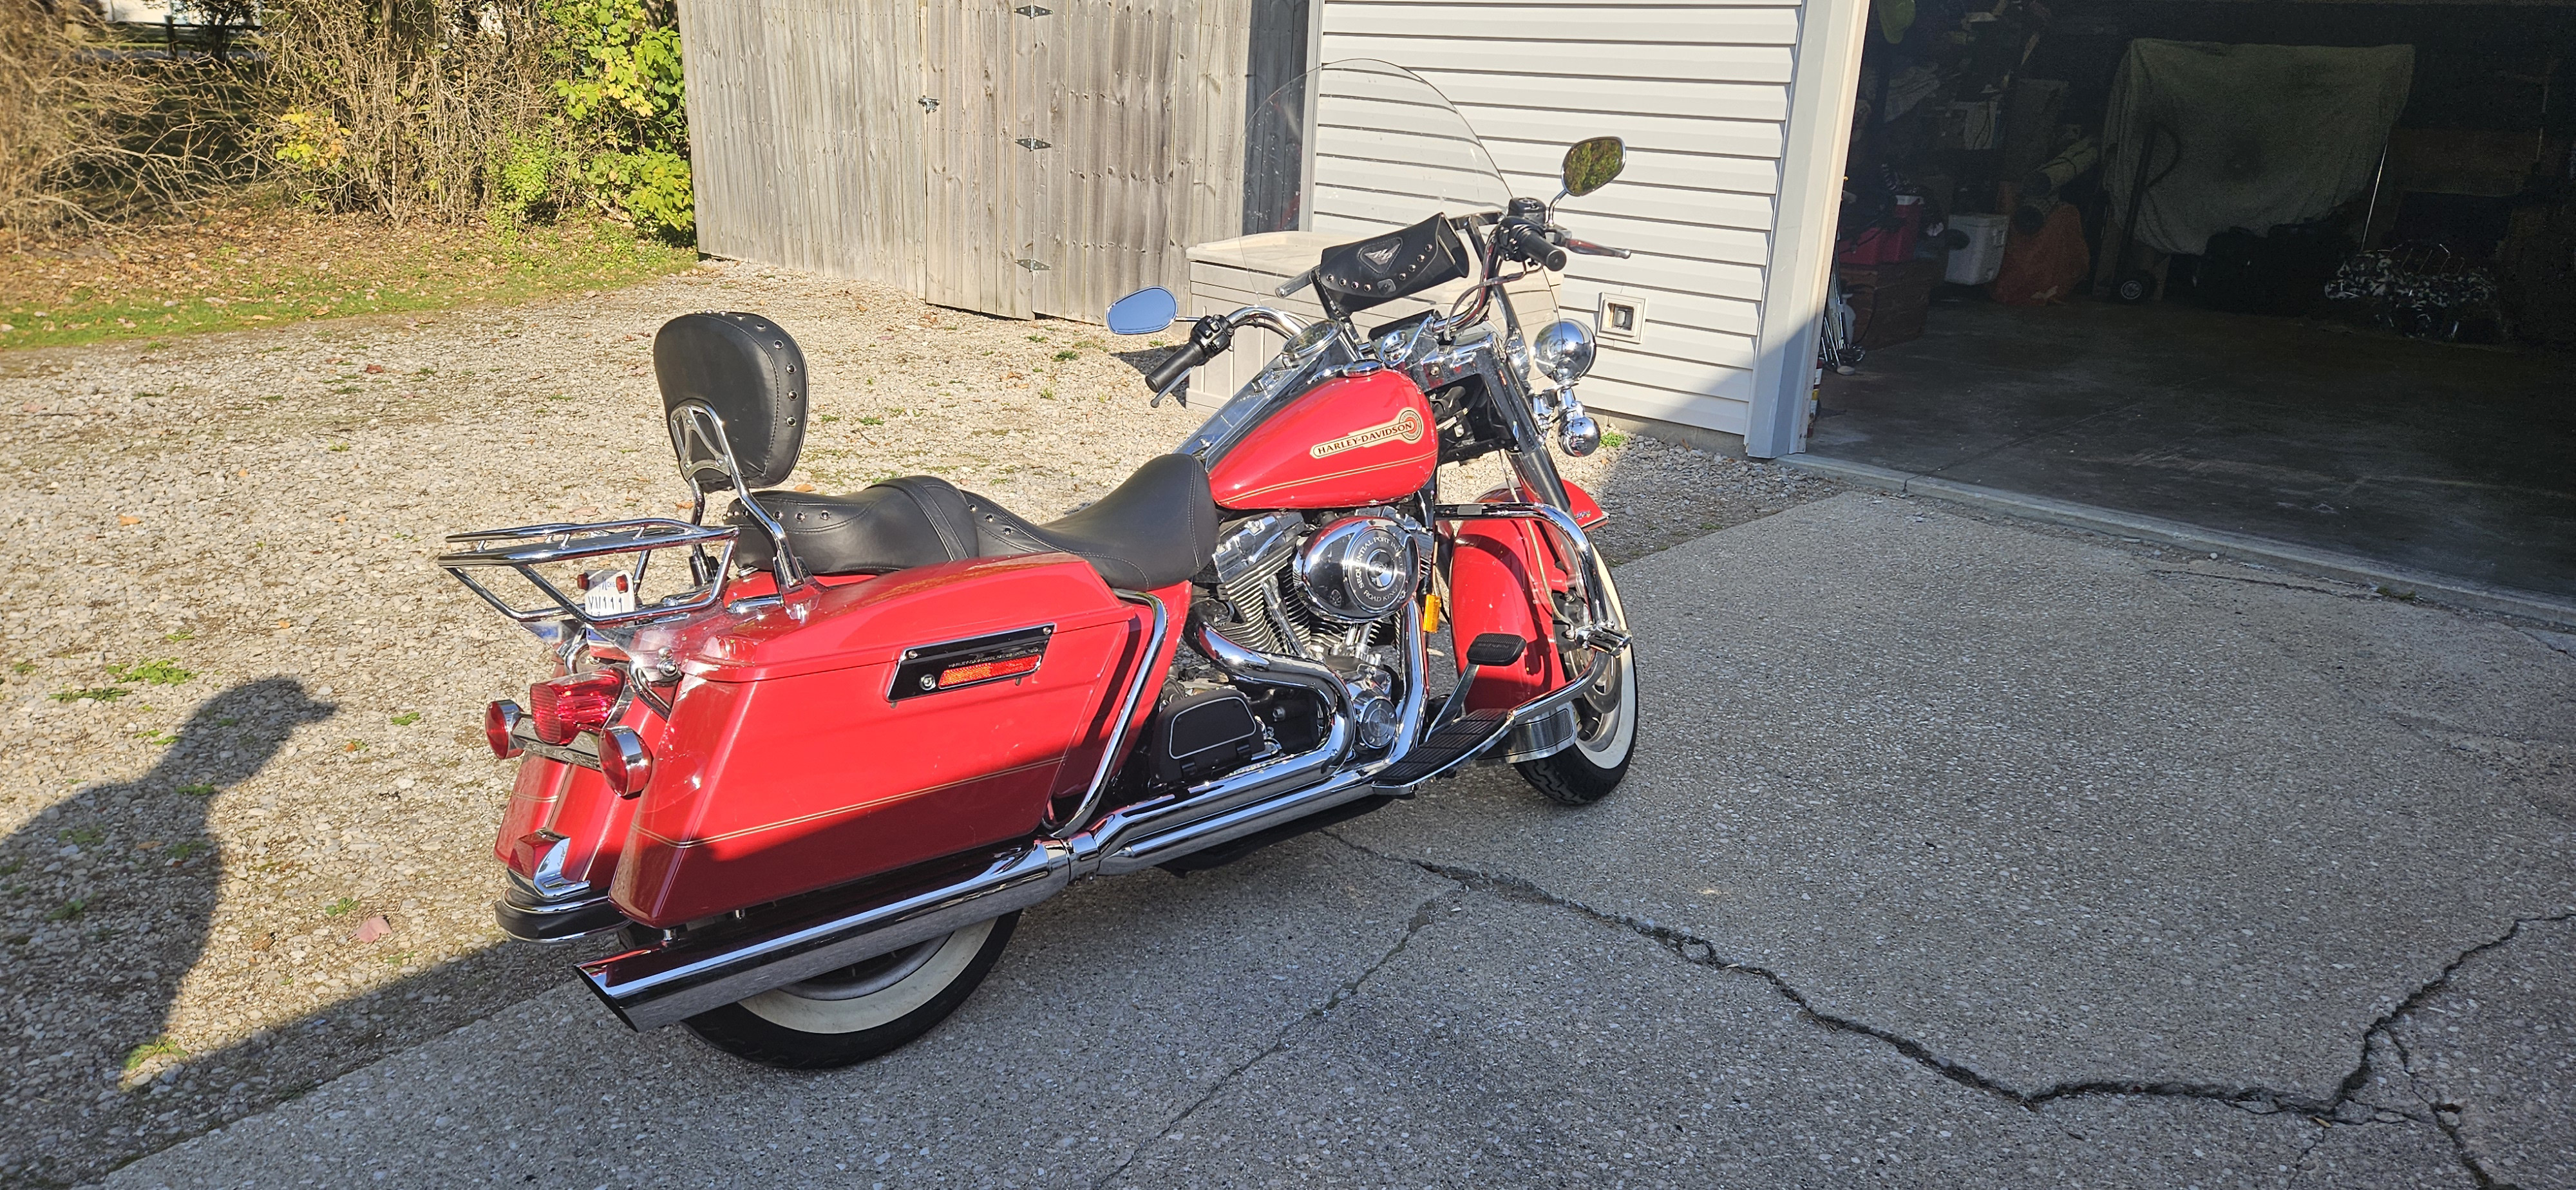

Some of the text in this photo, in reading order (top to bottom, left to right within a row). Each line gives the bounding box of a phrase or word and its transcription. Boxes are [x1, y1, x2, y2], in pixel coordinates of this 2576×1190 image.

[1318, 422, 1412, 455] HARLEY-DAVIDSON
[1355, 540, 1374, 589] SEQUNTIAL
[1363, 587, 1398, 602] ROAD KING
